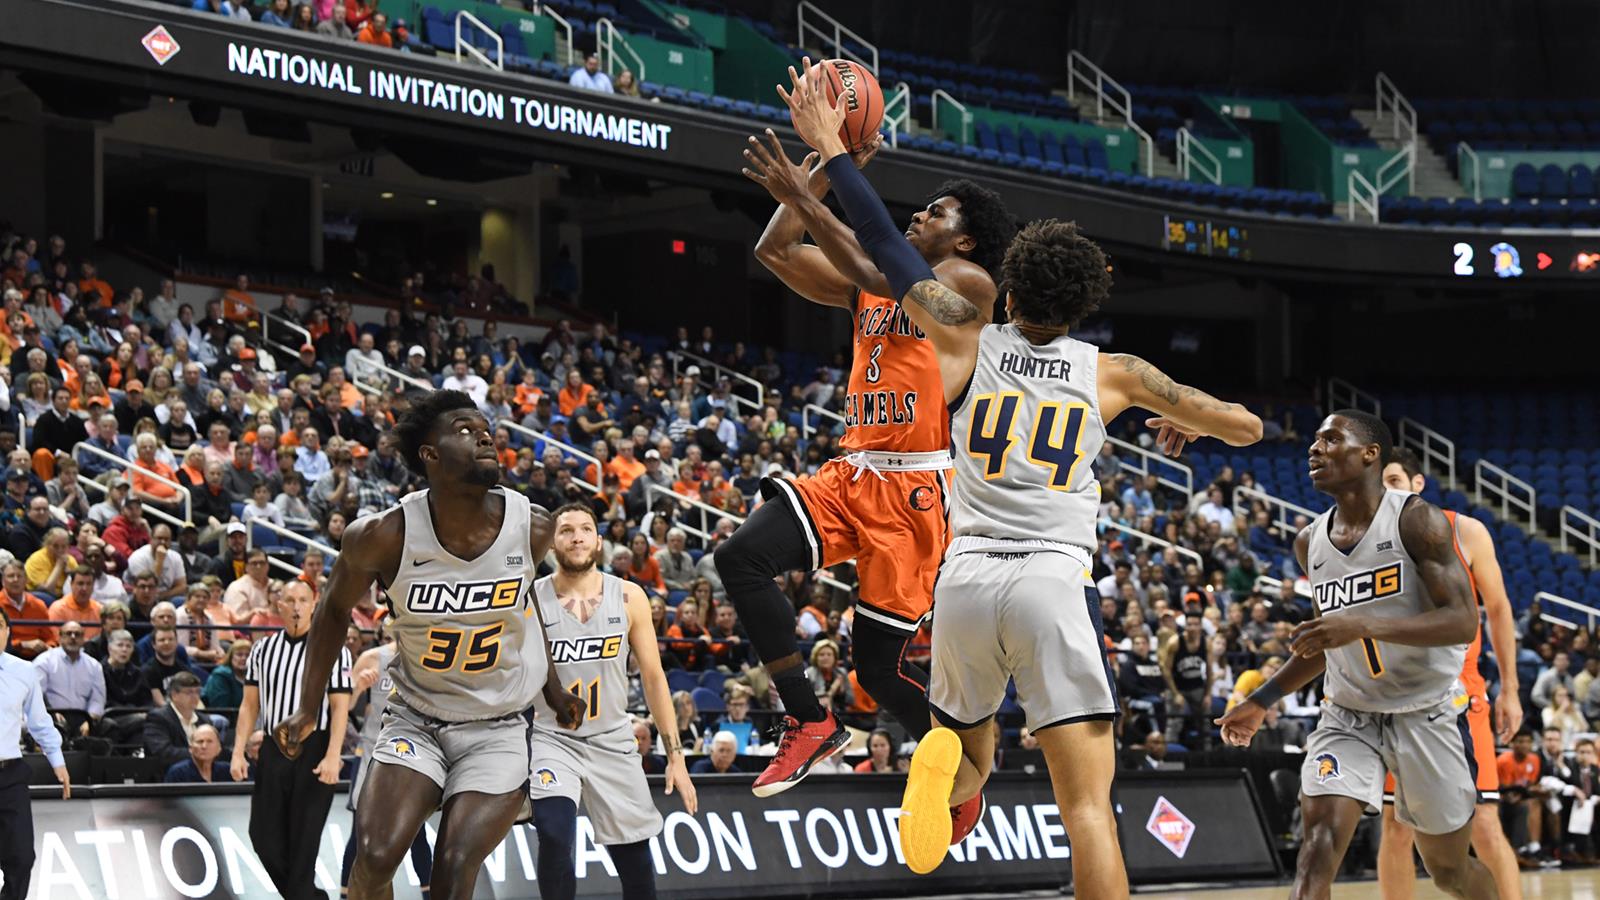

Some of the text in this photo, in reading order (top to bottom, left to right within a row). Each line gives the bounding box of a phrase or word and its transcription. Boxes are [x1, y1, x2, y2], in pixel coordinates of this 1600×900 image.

[227, 42, 672, 151] NATIONAL INVITATION TOURNAMENT
[832, 60, 860, 112] Wilson
[1453, 242, 1474, 276] 2
[867, 342, 883, 383] 3
[999, 352, 1071, 382] HUNTER
[966, 390, 1088, 491] 44
[406, 575, 525, 614] UNCG
[1314, 560, 1403, 614] UNCG
[420, 621, 505, 674] 35
[549, 632, 625, 664] UNCG
[1360, 637, 1385, 679] 1
